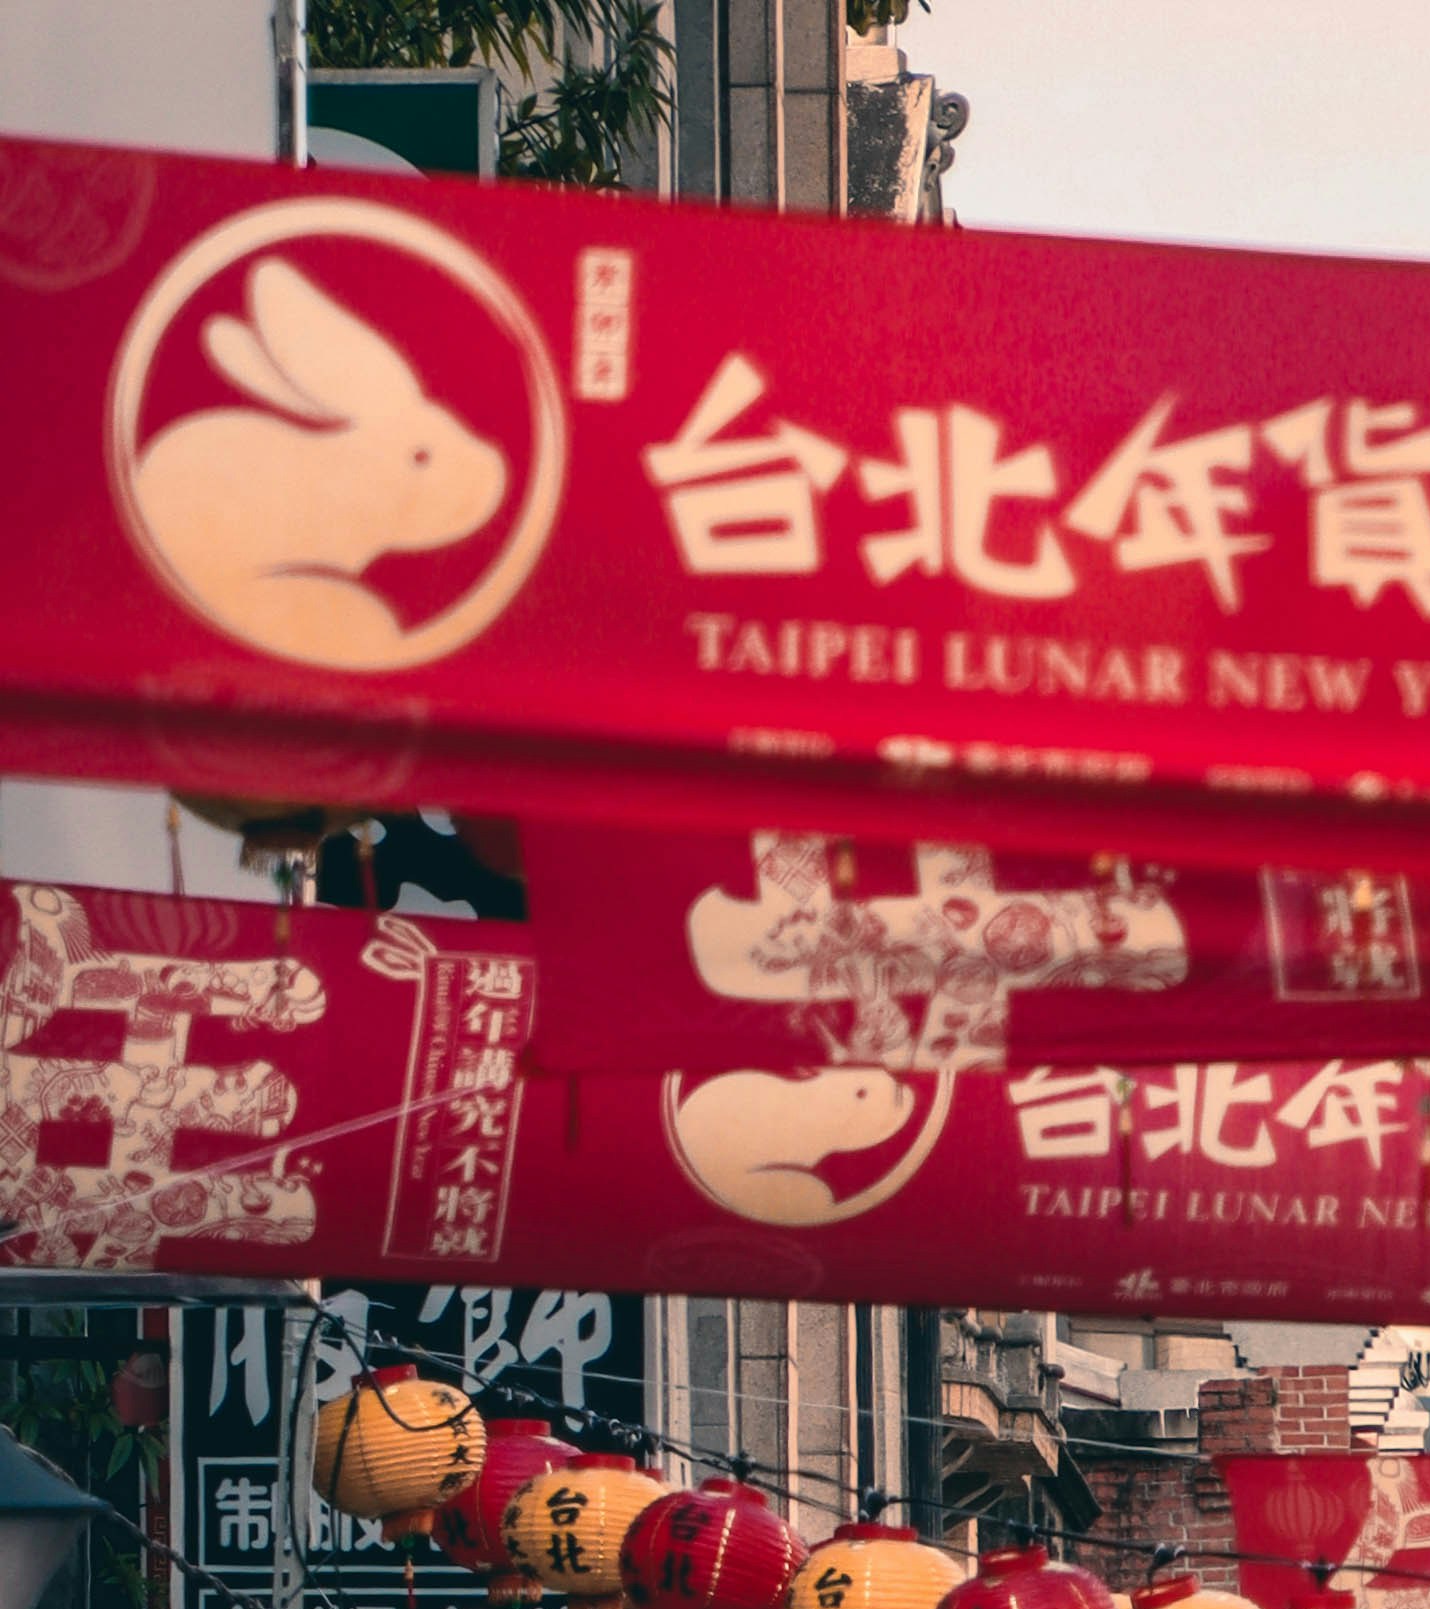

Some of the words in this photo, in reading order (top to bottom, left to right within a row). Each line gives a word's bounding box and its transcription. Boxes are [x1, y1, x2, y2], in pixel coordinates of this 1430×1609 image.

[686, 612, 919, 686] TAIPEI
[943, 631, 1189, 704] LUNAR
[1207, 650, 1371, 713] NEW
[1020, 1184, 1168, 1218] TAIPEI
[1186, 1190, 1338, 1225] LUNAR
